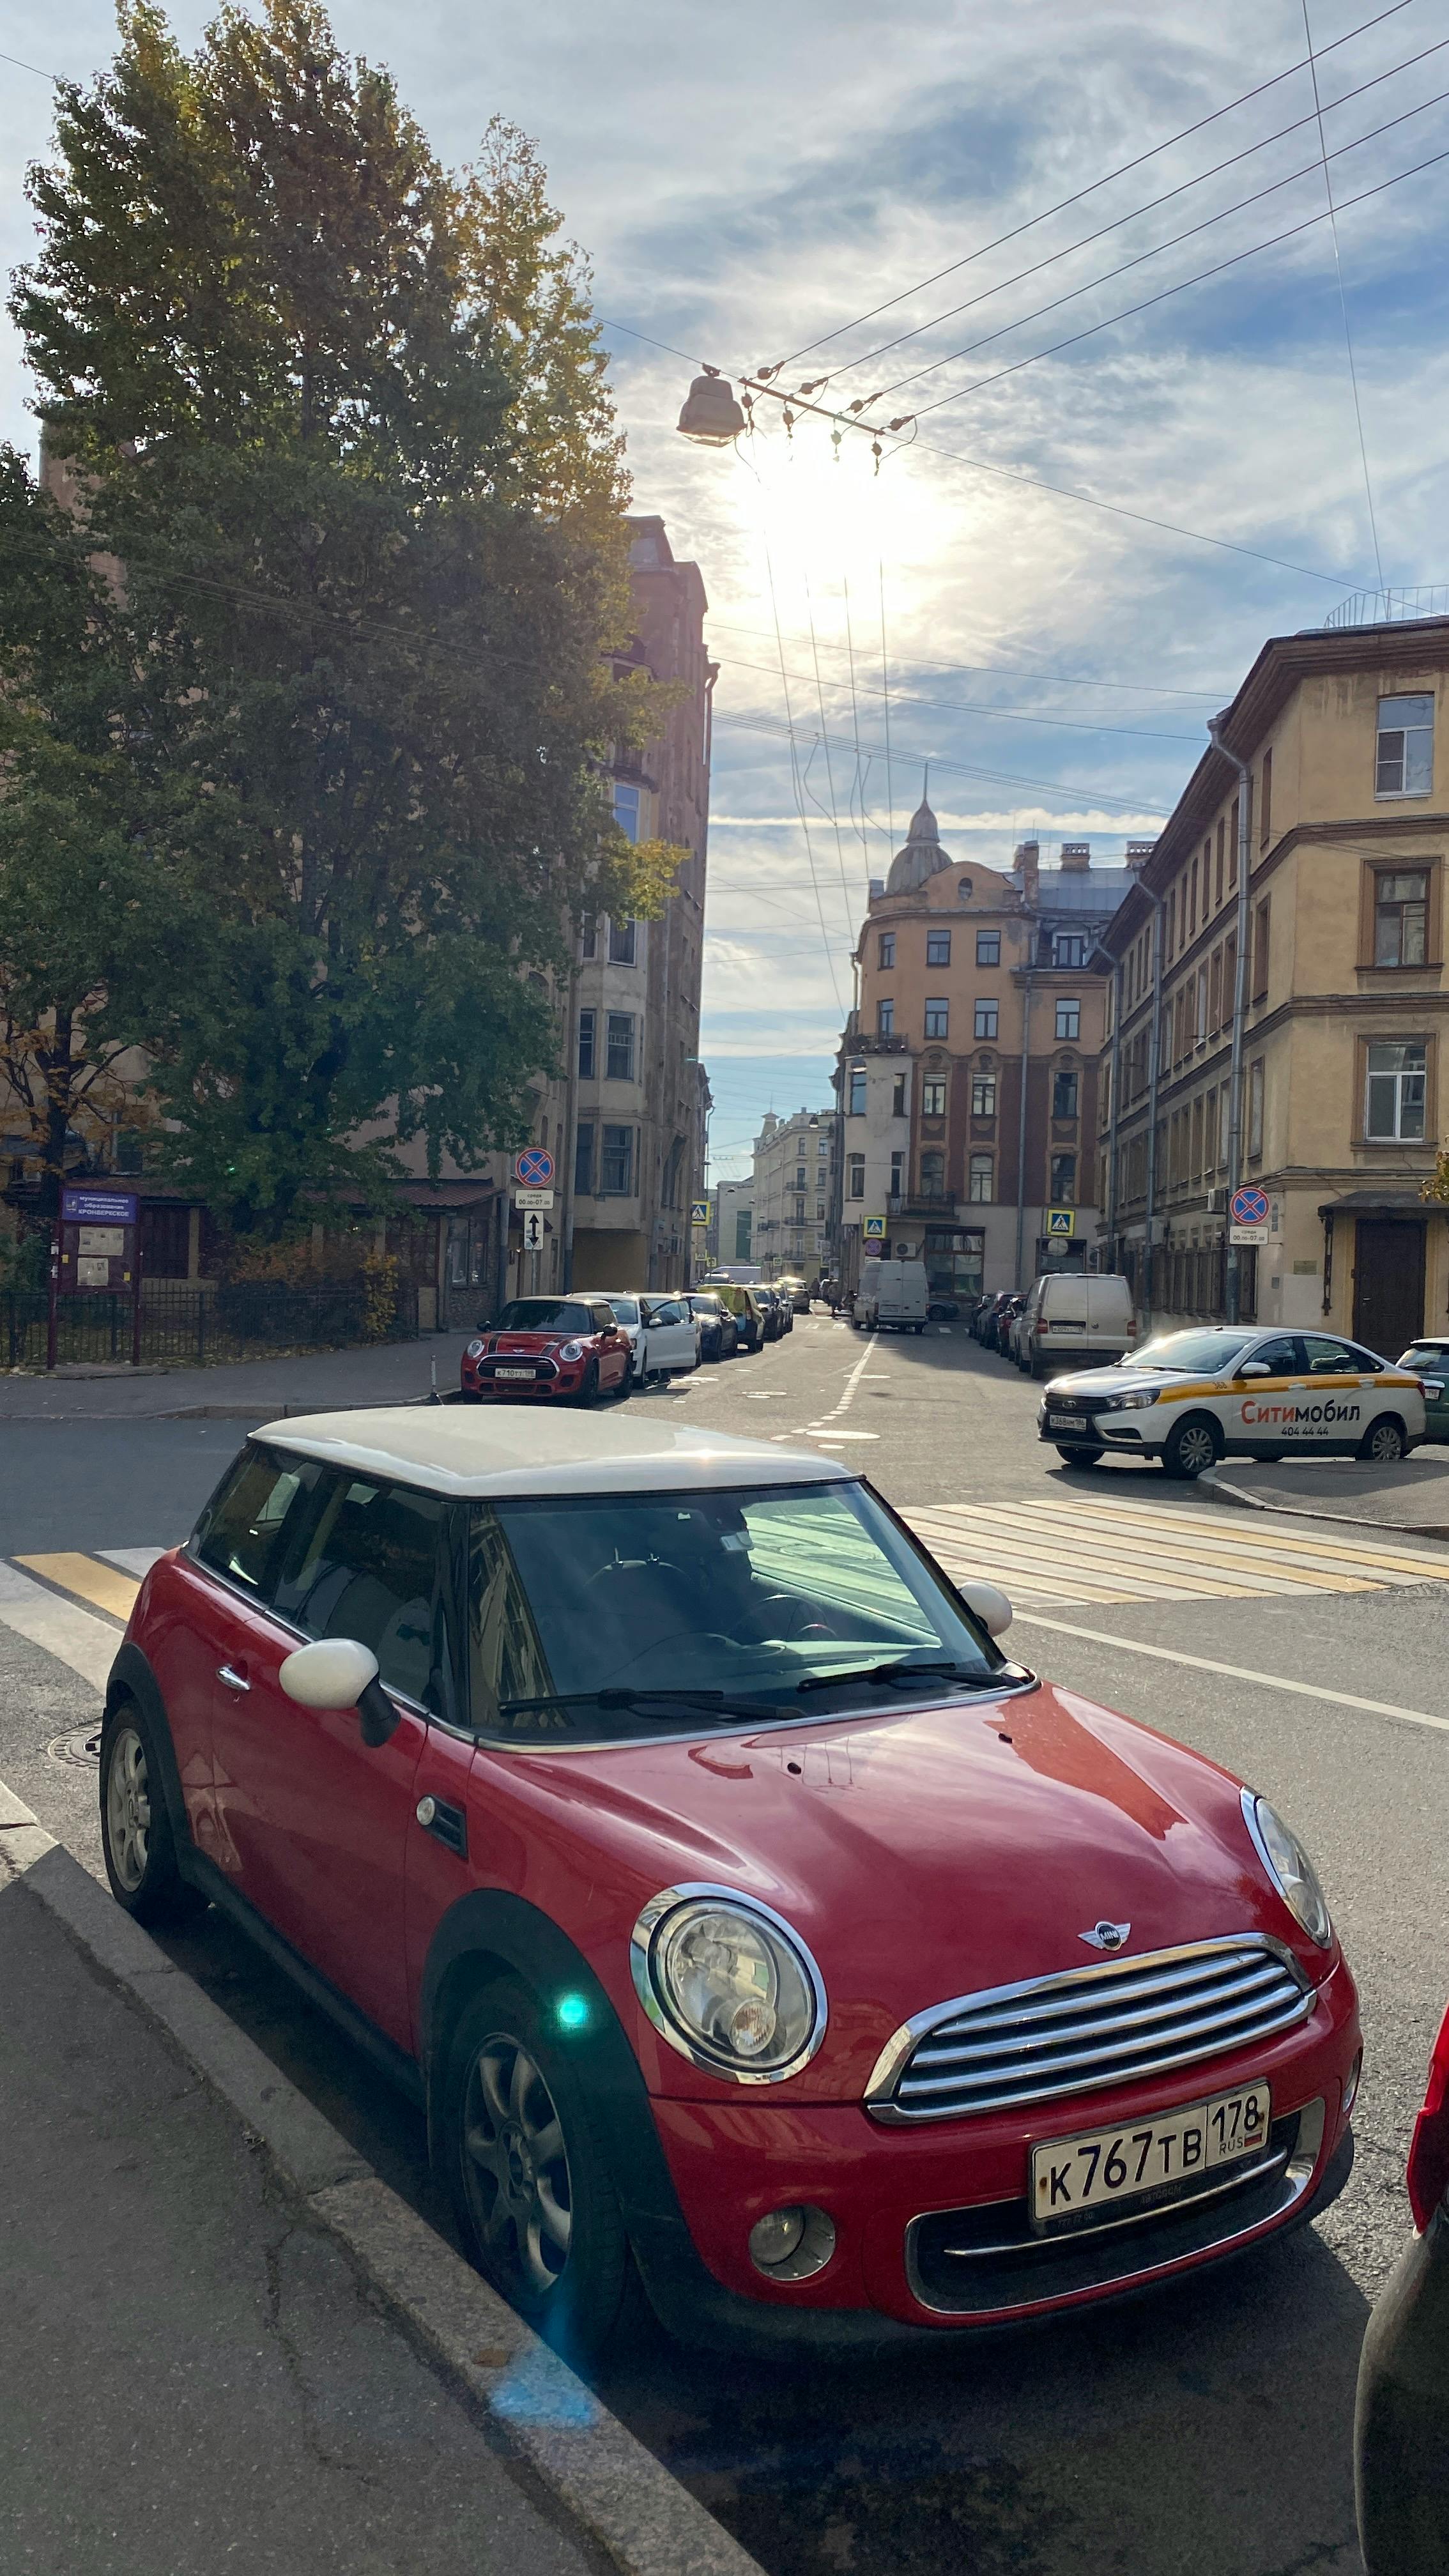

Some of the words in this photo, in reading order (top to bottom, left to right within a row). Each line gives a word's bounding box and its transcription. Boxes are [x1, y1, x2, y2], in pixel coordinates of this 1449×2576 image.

[78, 1209, 130, 1217] КРОНВЕРКСКОЕ
[1241, 1399, 1360, 1424] Ситимобил
[1281, 1426, 1300, 1436] 404
[1302, 1426, 1314, 1436] 44
[1317, 1426, 1329, 1436] 44
[1100, 1930, 1119, 1940] MINI
[1050, 2128, 1202, 2205] К767ТВ
[1211, 2095, 1258, 2142] 178
[1219, 2136, 1244, 2156] RUS
